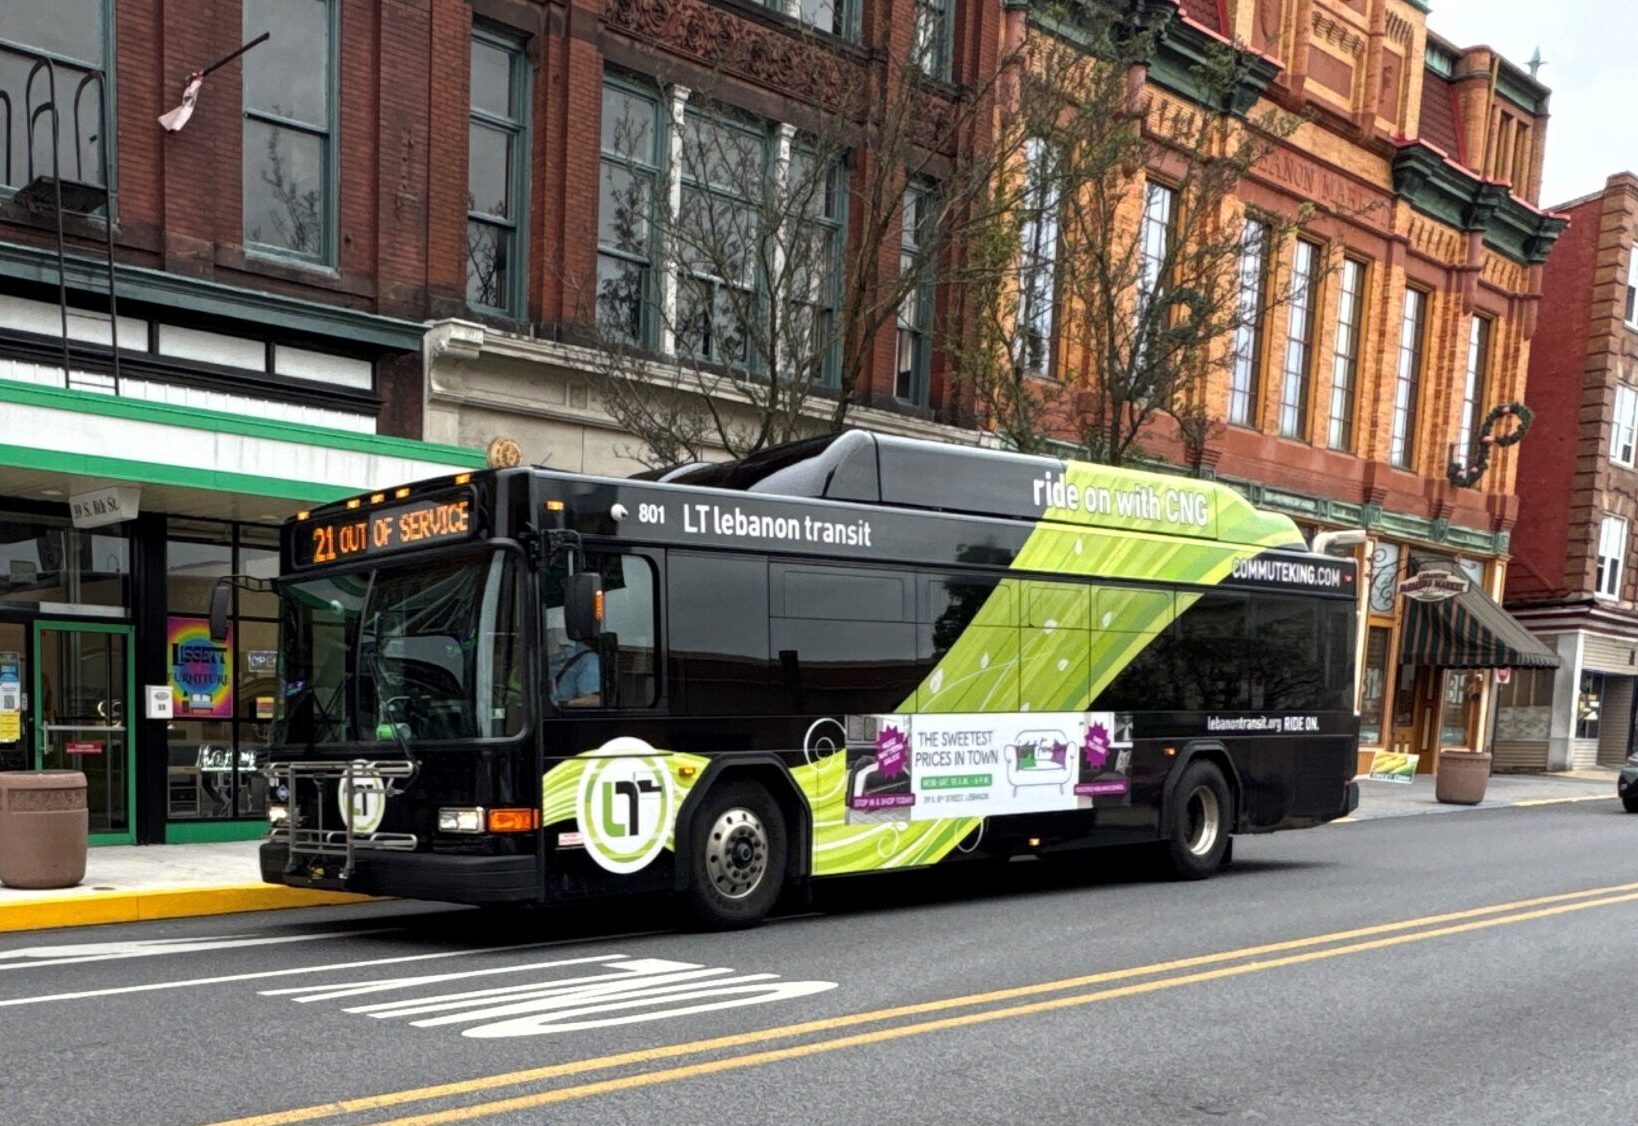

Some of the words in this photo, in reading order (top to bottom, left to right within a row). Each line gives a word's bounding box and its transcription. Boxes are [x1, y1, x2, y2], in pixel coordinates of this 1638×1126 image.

[1033, 471, 1080, 511] ride
[1084, 486, 1112, 515] on
[1116, 483, 1162, 521] with
[1165, 489, 1209, 527] CNG
[638, 503, 665, 525] 801
[683, 503, 710, 534] LT
[713, 505, 801, 541] lebanon
[804, 515, 872, 548] transit
[312, 525, 336, 563] 21
[339, 522, 368, 554] OUT
[373, 517, 394, 547] OF
[399, 501, 469, 543] SERVICE
[1231, 556, 1341, 588] COMMUTEKING.COM
[1207, 715, 1282, 733] lebanontransit.org
[1284, 716, 1304, 731] RIDE
[918, 731, 939, 748] THE
[941, 730, 994, 747] SWEETEST
[915, 750, 951, 768] PRICES
[955, 751, 965, 765] IN
[968, 750, 999, 766] TOWN
